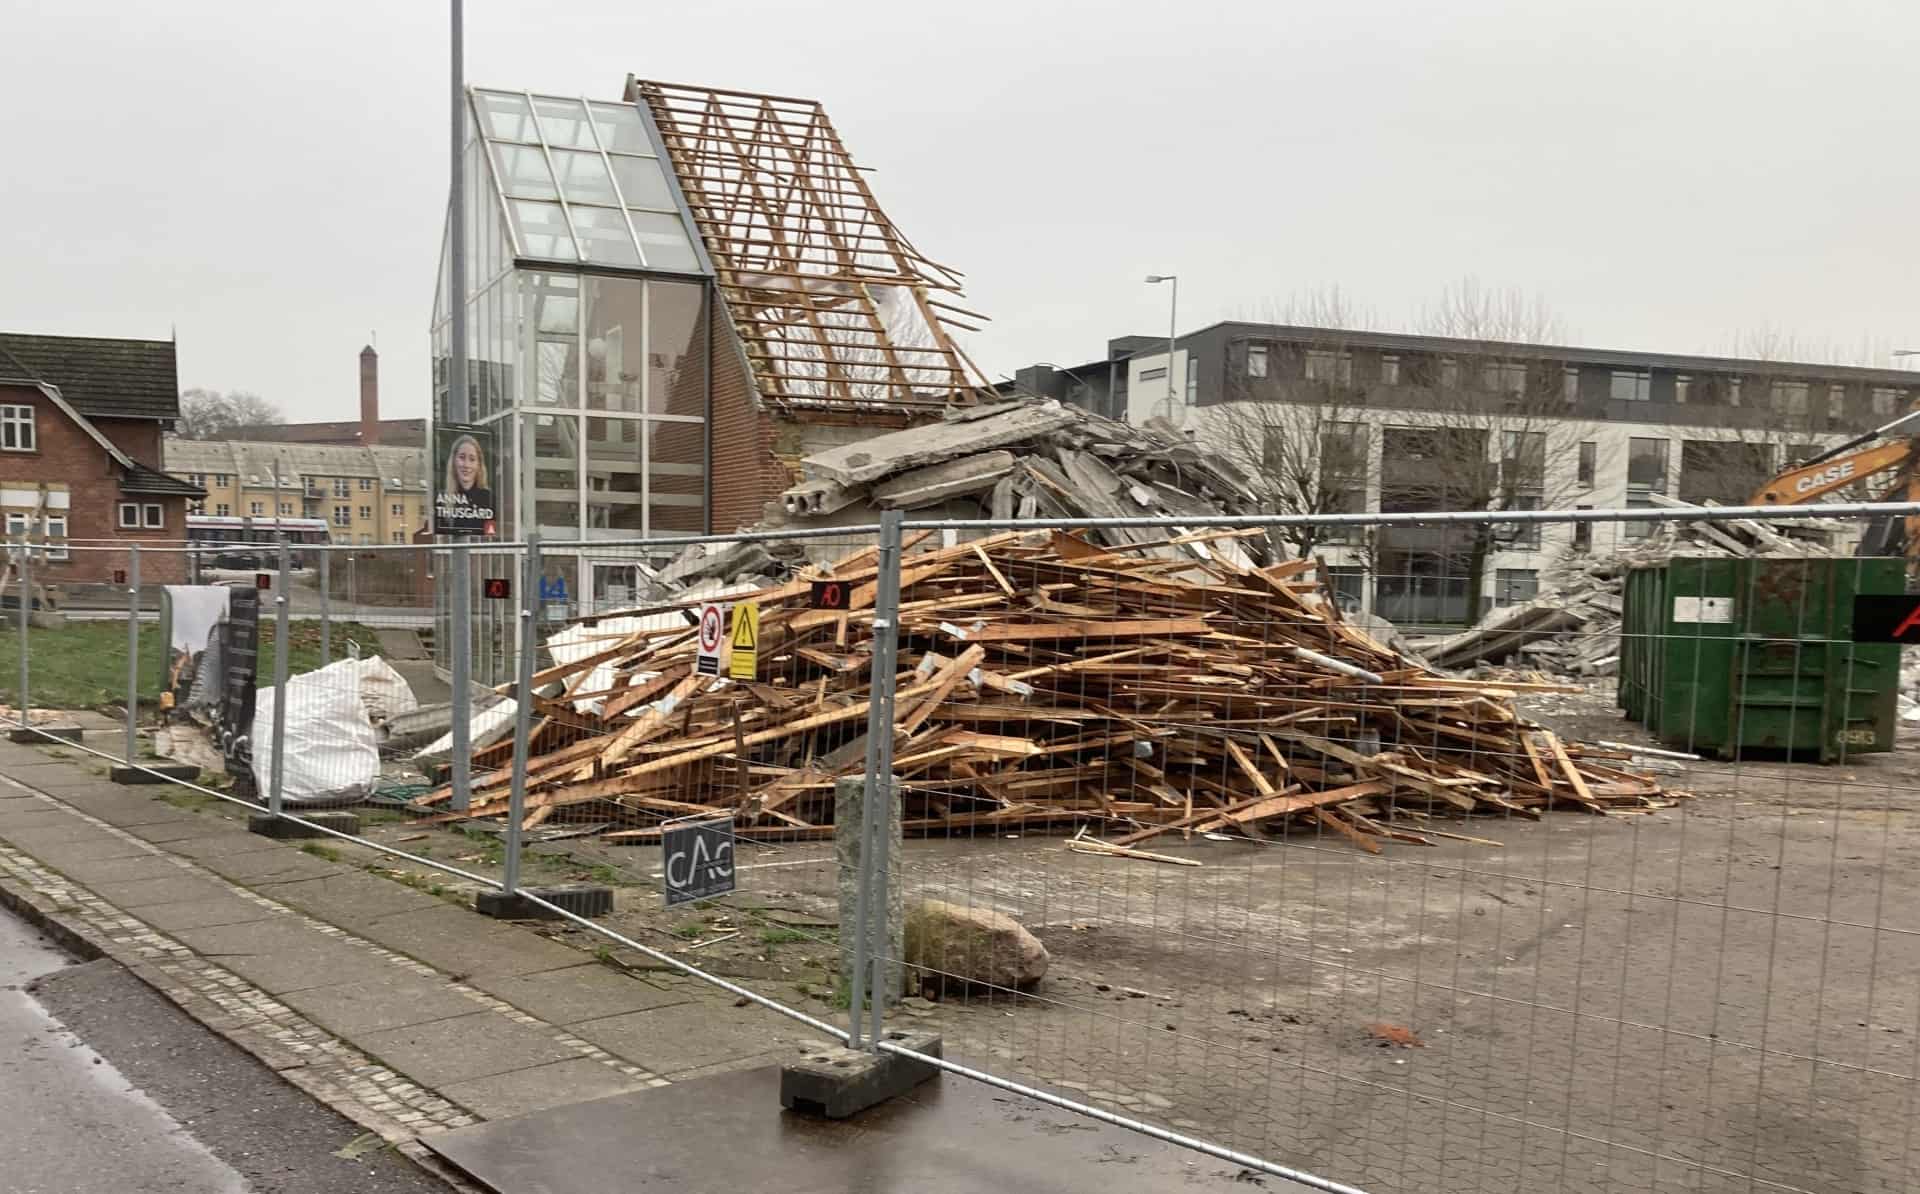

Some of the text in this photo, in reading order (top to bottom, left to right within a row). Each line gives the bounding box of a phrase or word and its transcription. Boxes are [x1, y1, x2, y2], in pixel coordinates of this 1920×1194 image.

[1797, 461, 1855, 492] CASE
[436, 493, 469, 504] ANNA
[436, 504, 493, 519] THUSGÅRD
